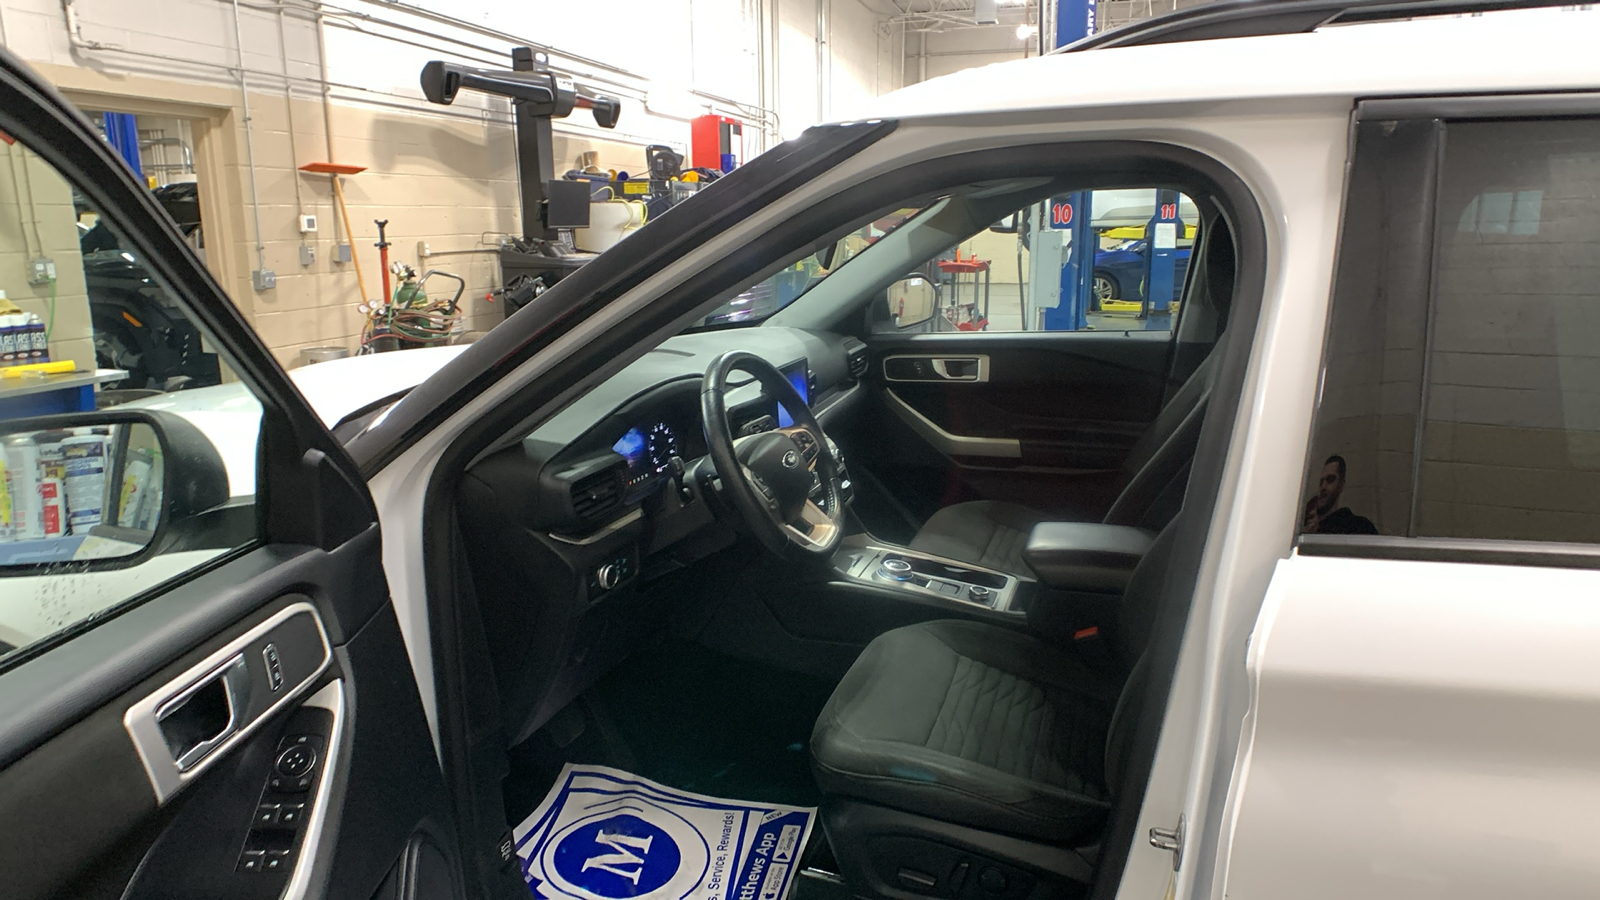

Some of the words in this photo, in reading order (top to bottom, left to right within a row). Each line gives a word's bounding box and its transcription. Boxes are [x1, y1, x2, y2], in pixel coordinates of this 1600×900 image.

[1053, 203, 1073, 224] 10
[1161, 203, 1176, 219] 11
[766, 811, 782, 820] NEW
[717, 812, 735, 851] Rewards!
[788, 827, 799, 836] Play
[756, 832, 777, 856] App
[783, 837, 795, 851] Google
[581, 829, 653, 885] M
[708, 853, 728, 890] Service,
[774, 867, 785, 880] Store
[771, 880, 781, 890] App
